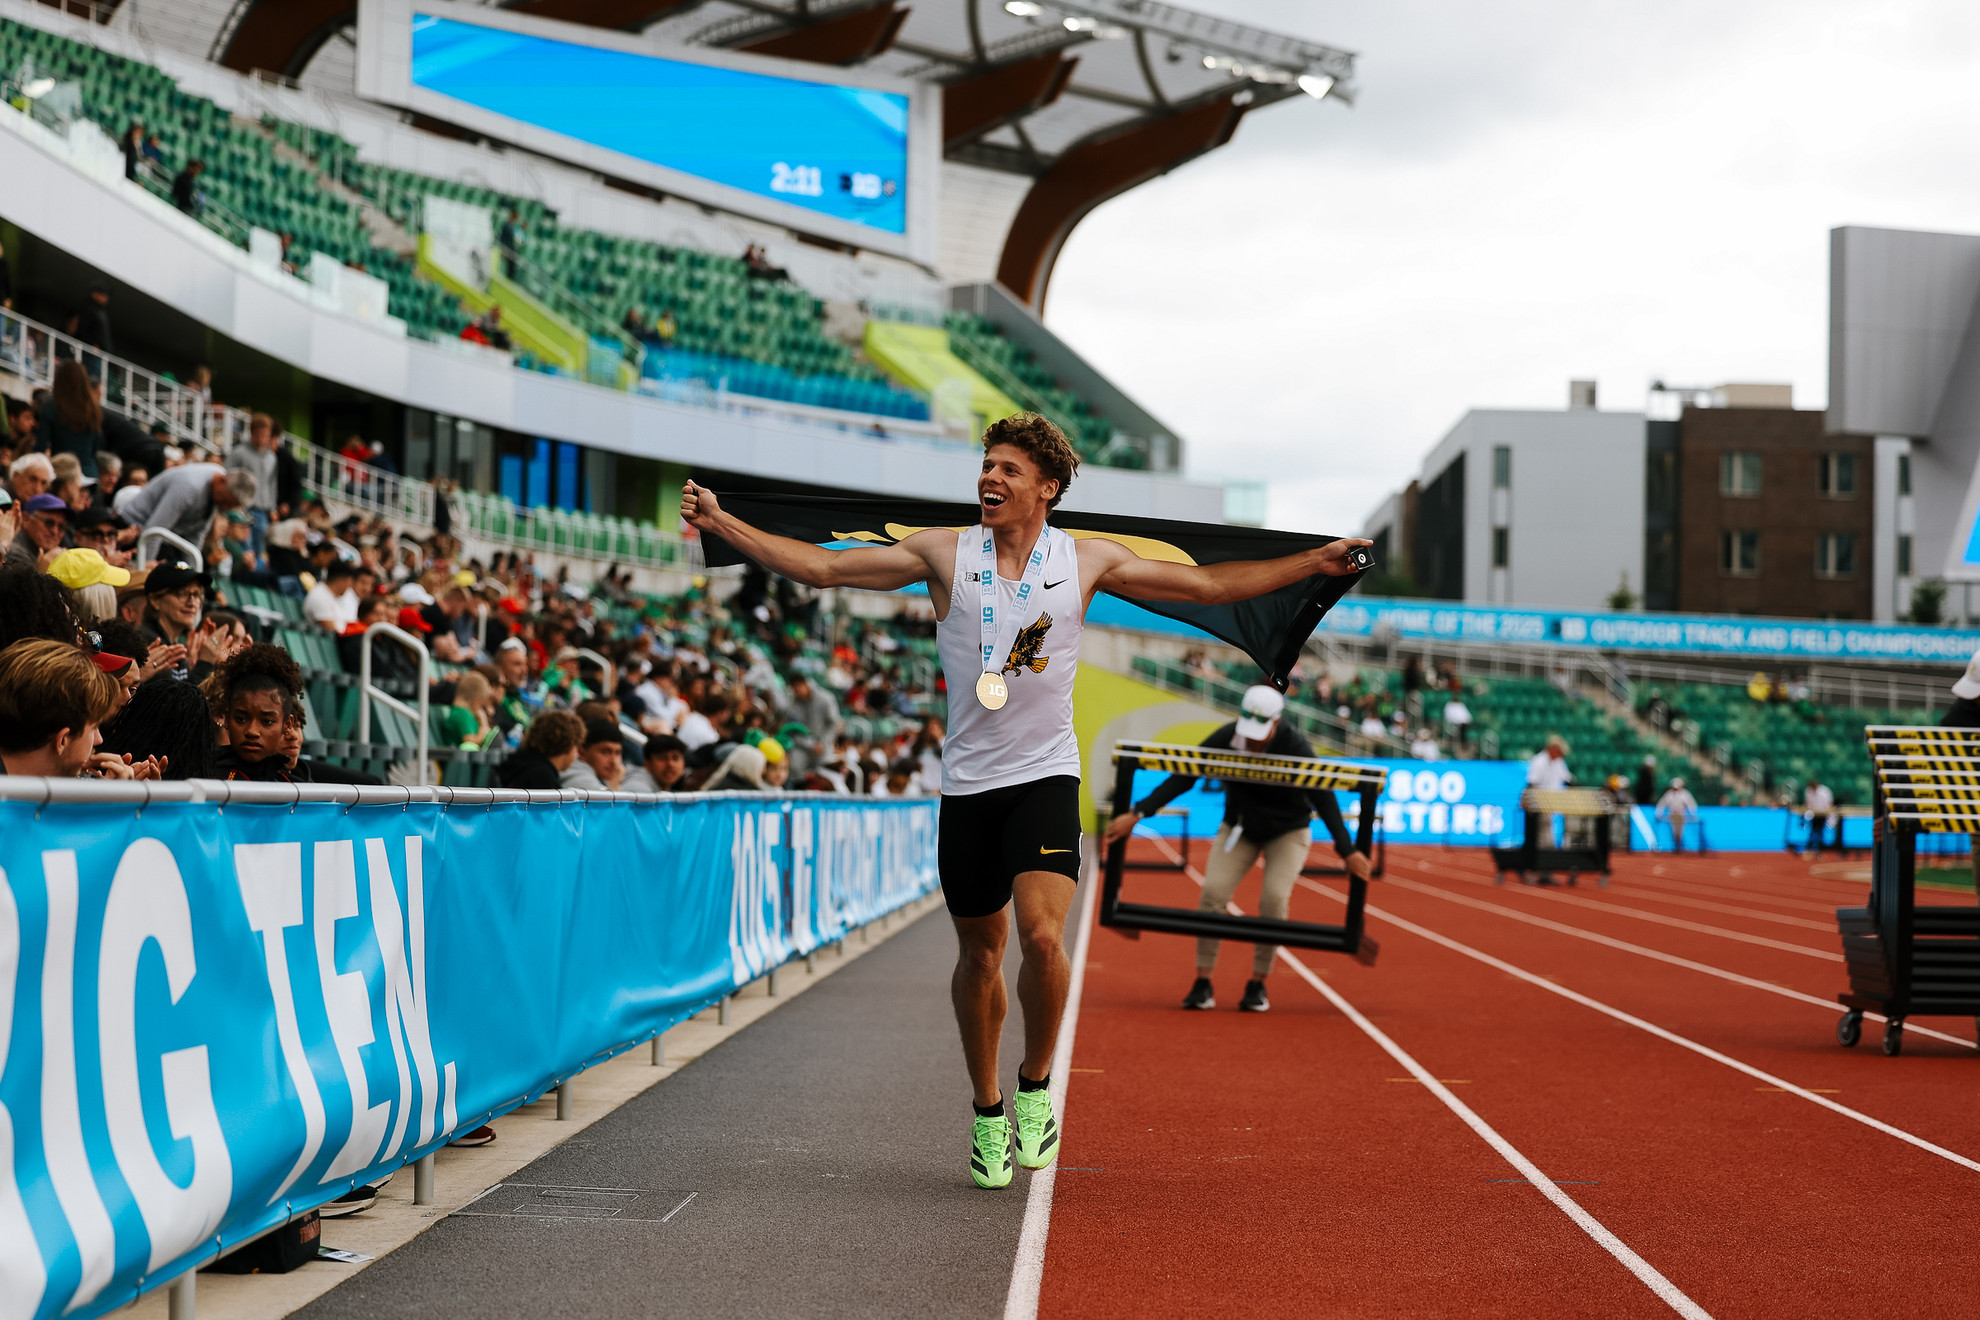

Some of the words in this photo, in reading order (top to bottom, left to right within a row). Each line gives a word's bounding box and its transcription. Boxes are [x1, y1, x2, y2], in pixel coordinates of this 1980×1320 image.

[1462, 612, 1495, 637] THE
[1591, 619, 1681, 646] OUTDOOR
[1685, 623, 1745, 649] TRACK
[1746, 627, 1788, 651] AND
[1790, 628, 1844, 653] FIELD
[1204, 764, 1291, 783] OREGON
[1388, 769, 1466, 803] 800
[234, 835, 457, 1205] TEN.
